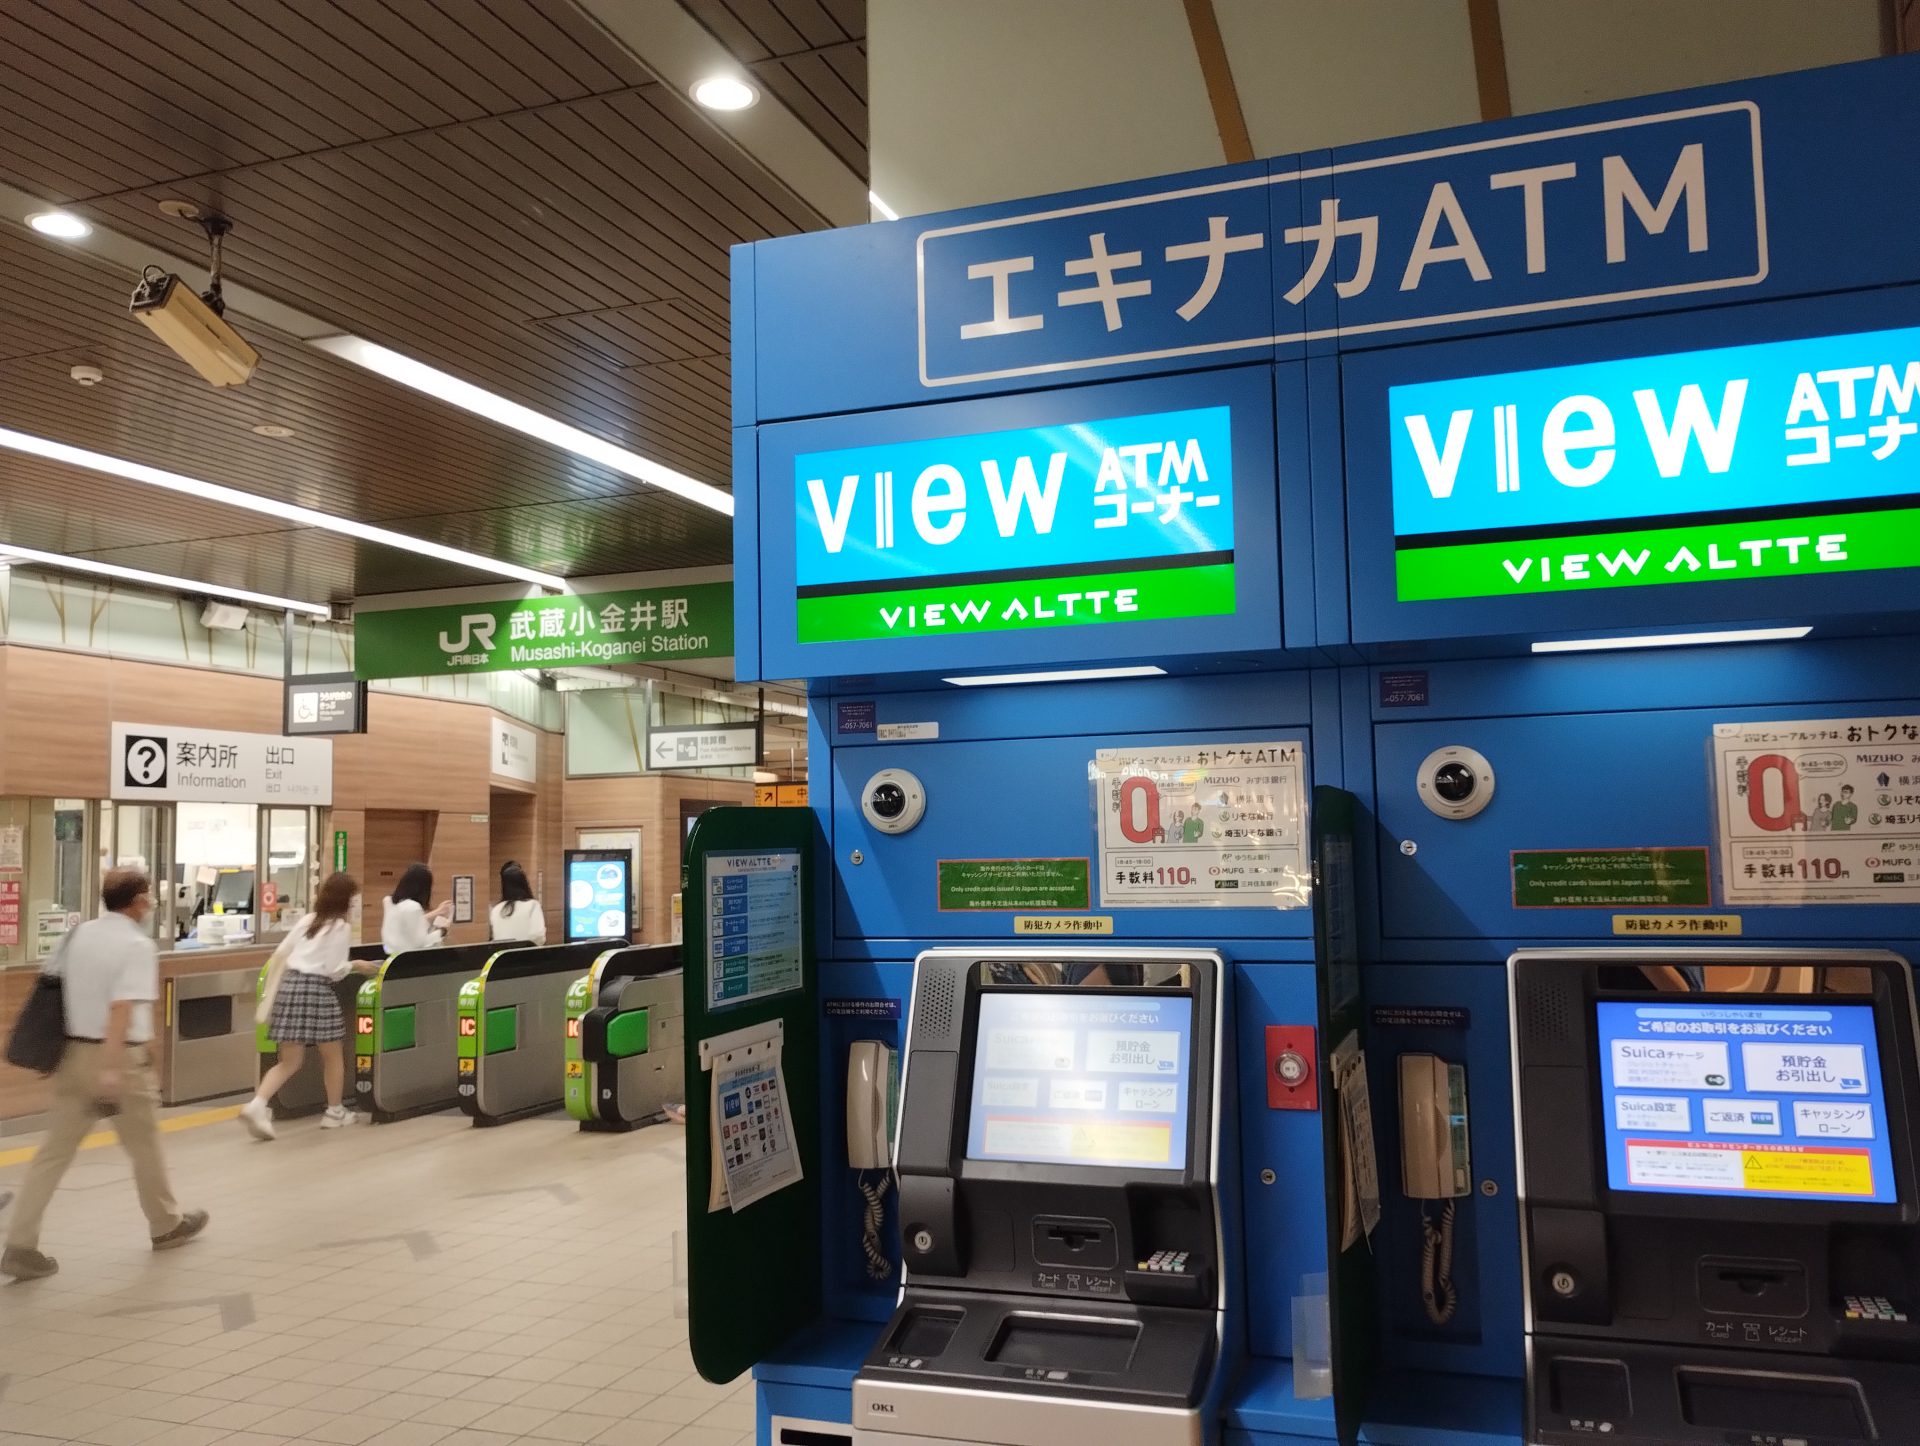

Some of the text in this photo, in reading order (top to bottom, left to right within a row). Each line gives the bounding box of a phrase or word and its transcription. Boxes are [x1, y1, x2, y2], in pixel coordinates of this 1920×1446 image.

[961, 143, 1708, 339] エキナカATM
[1785, 361, 1920, 425] ATM
[1093, 438, 1208, 492] ATM
[1093, 484, 1220, 530] コーナー
[1502, 534, 1848, 583] VIEW ALTTE
[880, 588, 1139, 628] VIEW ALTTE
[509, 598, 689, 641] 武蔵小金井駅
[439, 613, 496, 653] JR
[511, 633, 709, 663] Musashi-Koganei Station
[447, 653, 490, 666] JR東日本
[176, 741, 238, 769] 案内所
[265, 745, 295, 765] 出口
[177, 772, 247, 789] Information
[265, 768, 283, 780] Exit
[1115, 871, 1154, 885] 手数料
[1621, 879, 1642, 887] Japan
[1024, 920, 1102, 930] 防犯カメラ作動中
[1625, 919, 1728, 930] 防犯カメラ作動中
[358, 1017, 373, 1033] IC
[461, 1018, 475, 1035] IC
[1637, 1021, 1833, 1036] ご希望のお取引をお選びください
[1116, 1041, 1150, 1051] 預貯金
[1110, 1053, 1155, 1064] お引出し
[1621, 1046, 1704, 1060] Suicaチャージ
[1781, 1055, 1827, 1068] 預貯金
[1776, 1070, 1836, 1083] お引出し
[1124, 1087, 1173, 1097] キャッシング
[1136, 1100, 1161, 1109] ローン
[1621, 1102, 1676, 1113] Suica設定
[1710, 1112, 1744, 1122] ご返済
[1800, 1109, 1865, 1120] キャッシング
[1819, 1124, 1851, 1133] ローン
[1038, 1273, 1060, 1282] カード
[1086, 1276, 1116, 1286] レシート
[1705, 1321, 1733, 1332] カード
[1769, 1326, 1807, 1337] レシート
[872, 1403, 895, 1413] OKI
